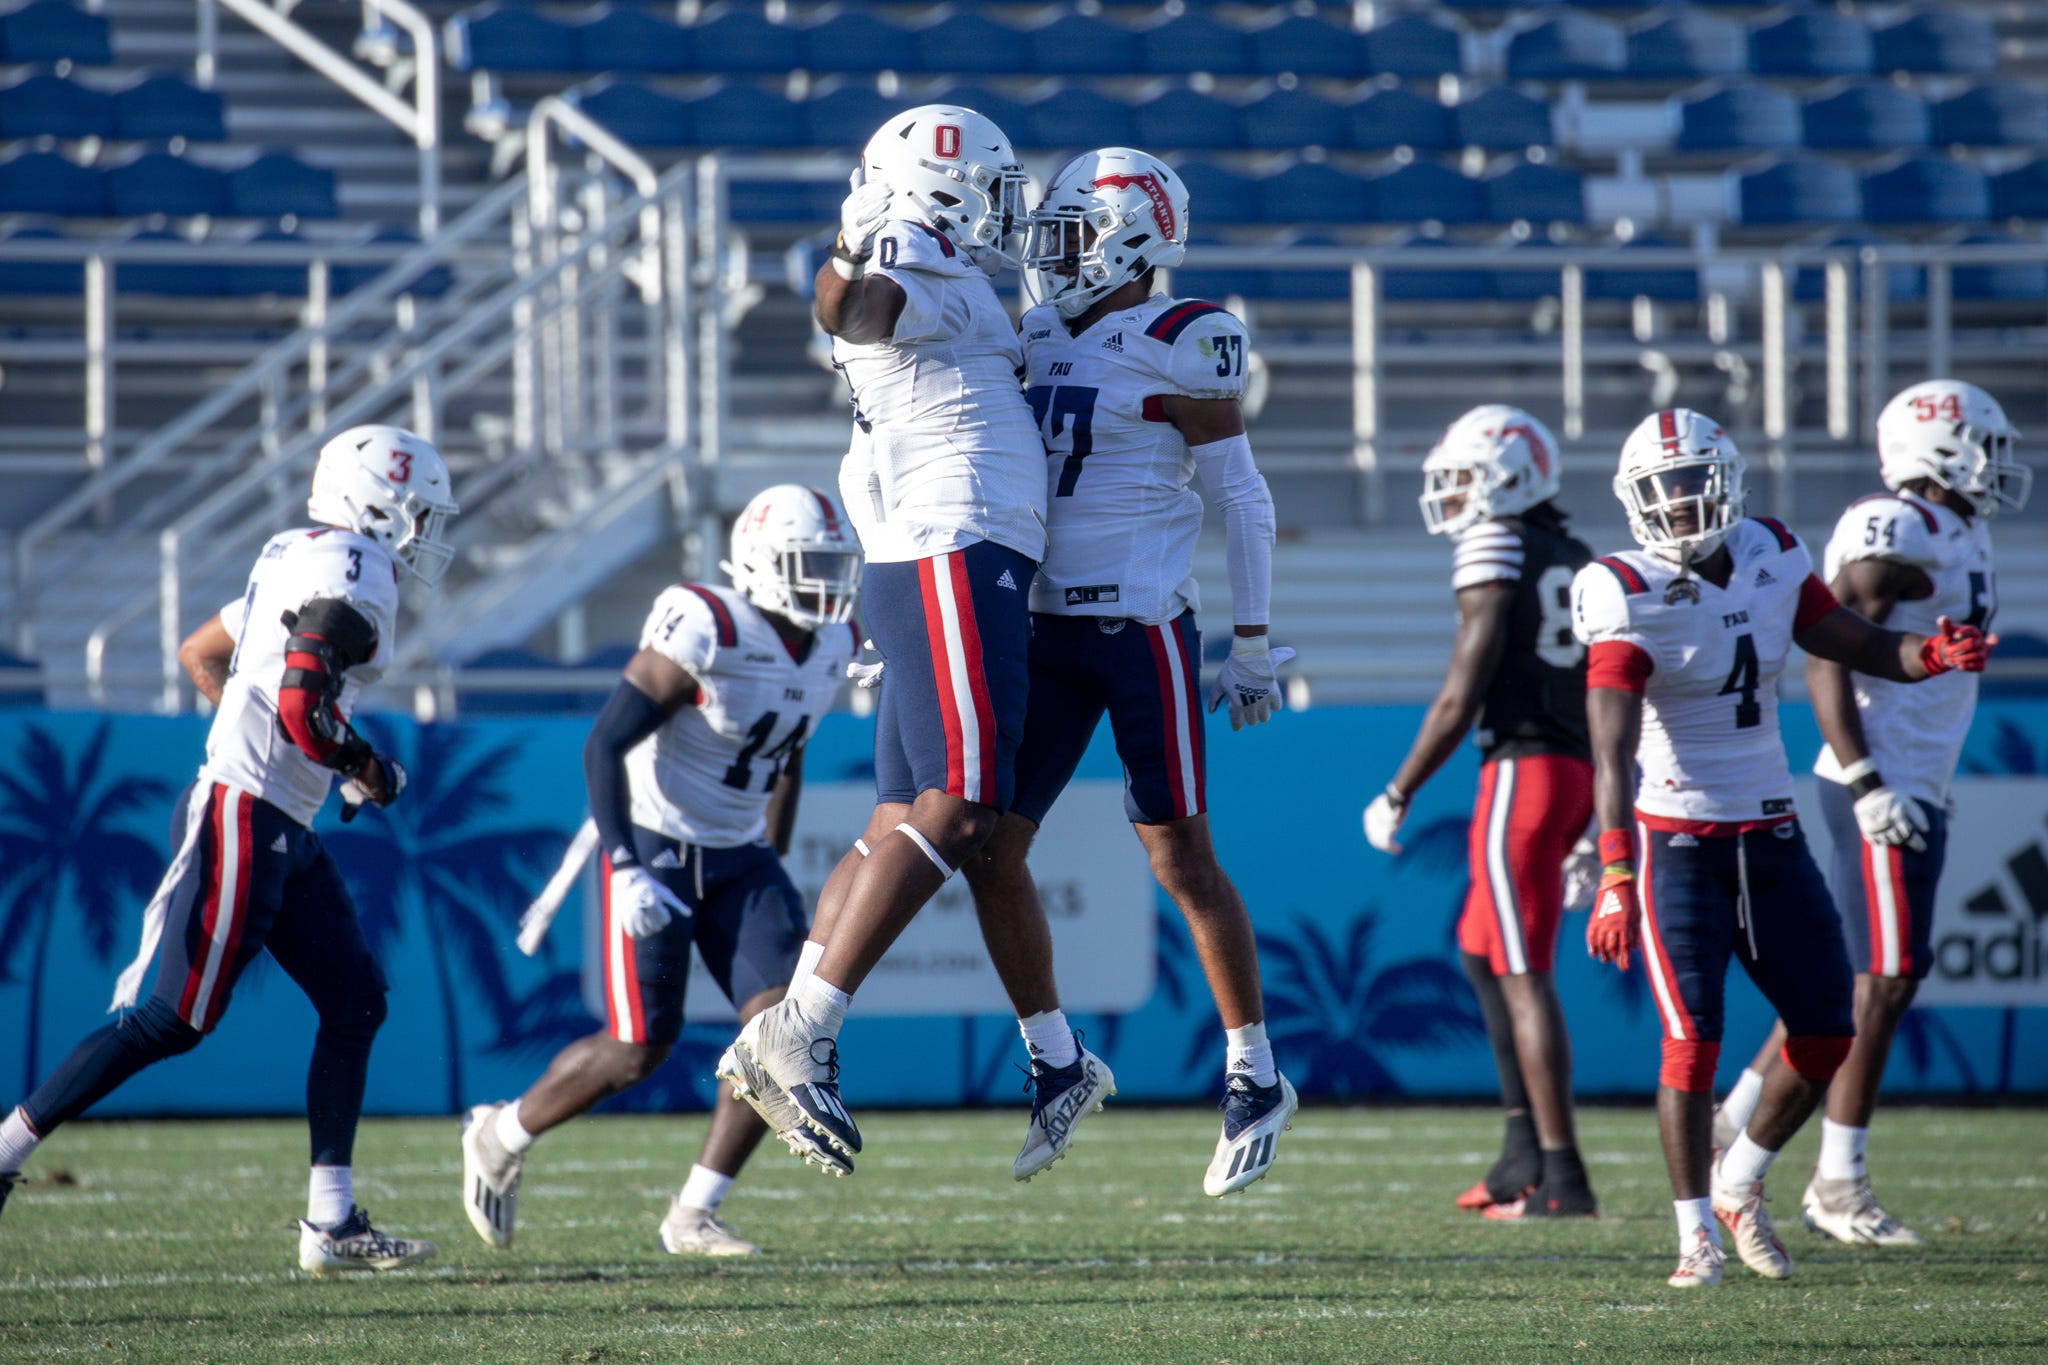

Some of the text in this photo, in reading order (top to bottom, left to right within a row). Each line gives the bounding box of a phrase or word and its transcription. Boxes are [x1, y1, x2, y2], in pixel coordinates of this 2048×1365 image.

[1143, 180, 1174, 238] ATLANTIC
[879, 237, 898, 269] 0
[1048, 362, 1074, 376] FAU
[1212, 335, 1242, 377] 37
[1914, 394, 1964, 422] 54
[388, 450, 414, 484] 3
[742, 504, 772, 533] 14
[1864, 517, 1896, 547] 54
[346, 548, 362, 582] 3
[655, 606, 685, 642] 14
[1721, 610, 1749, 628] FAU
[1716, 633, 1761, 729] 4
[1935, 920, 2048, 981] adi
